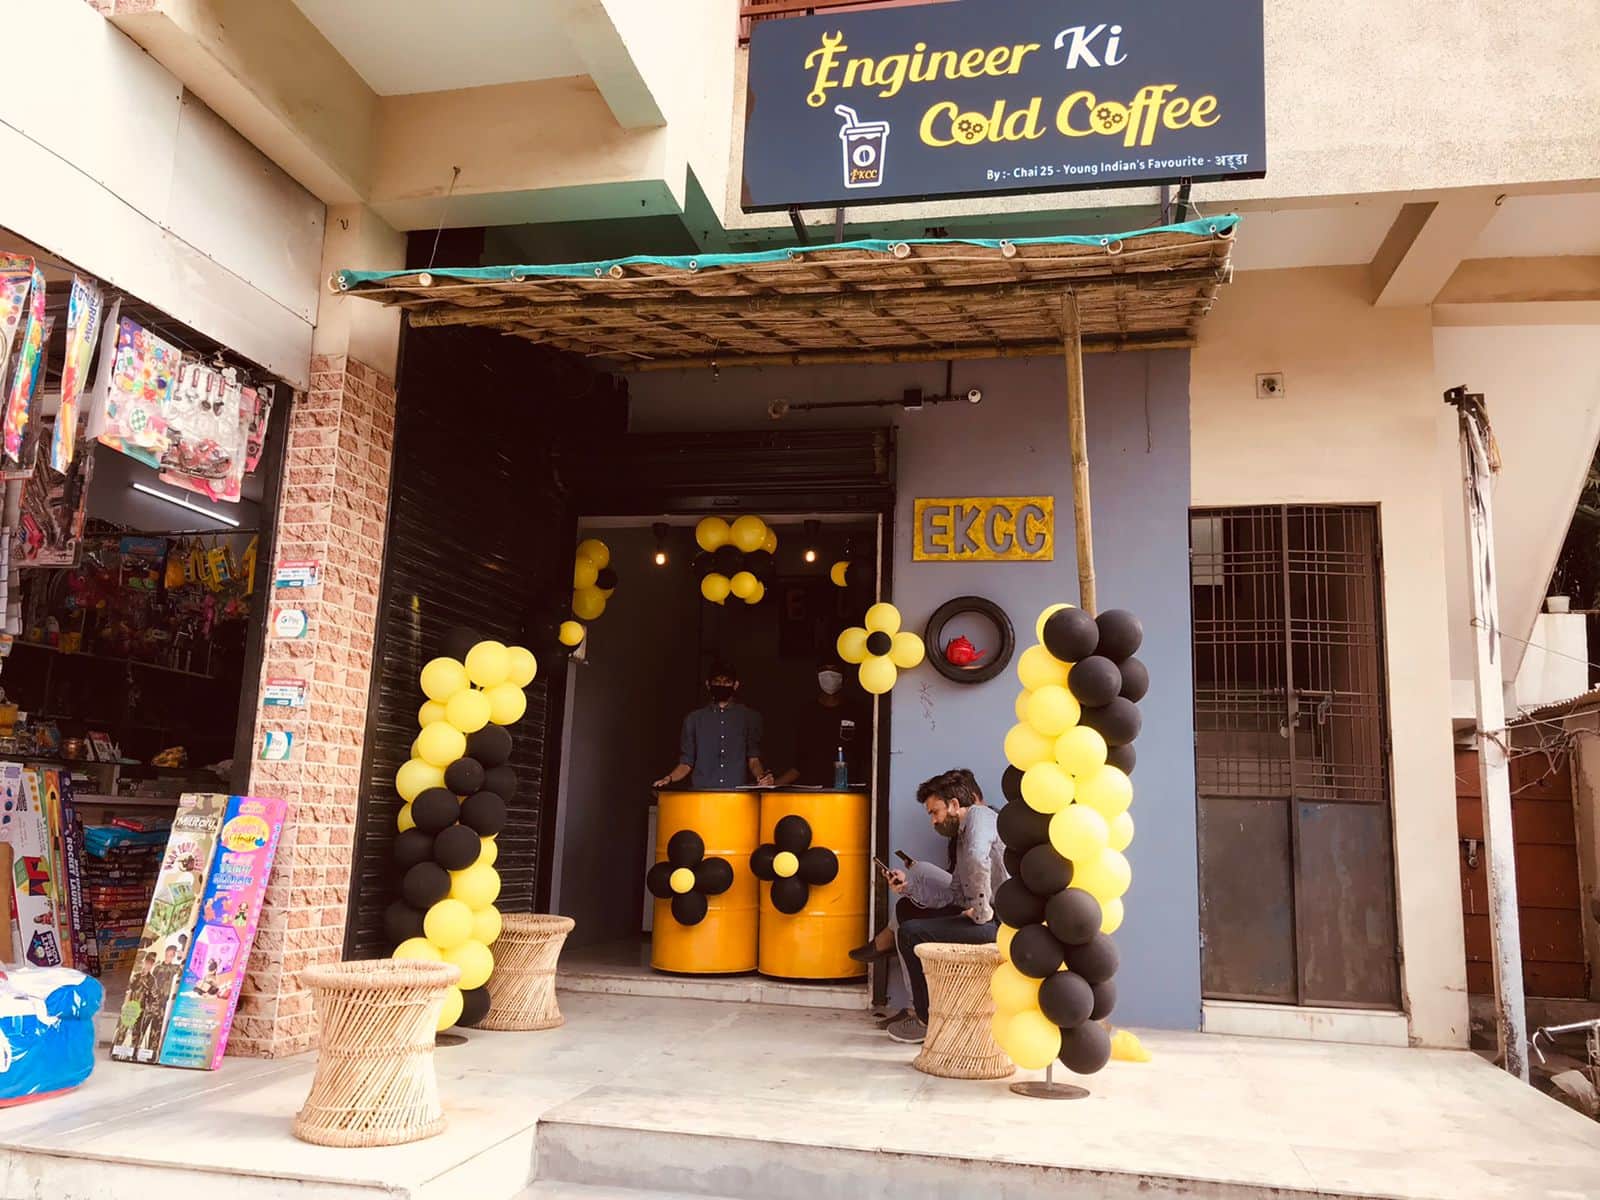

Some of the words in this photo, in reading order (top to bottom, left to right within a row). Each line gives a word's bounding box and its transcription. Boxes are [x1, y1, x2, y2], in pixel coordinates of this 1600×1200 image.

[804, 30, 1040, 107] Engineer
[1054, 23, 1128, 70] Ki
[919, 96, 1046, 147] Cold
[1056, 83, 1221, 147] Coffee
[986, 169, 1000, 181] By
[1013, 165, 1038, 178] Chai
[1040, 165, 1054, 176] 25
[1063, 163, 1098, 175] Young
[1100, 159, 1146, 172] Indian's
[1148, 155, 1204, 169] Favourite
[921, 503, 1047, 555] EKCC
[66, 836, 76, 876] ROCKET
[70, 878, 81, 931] LAUNCHER
